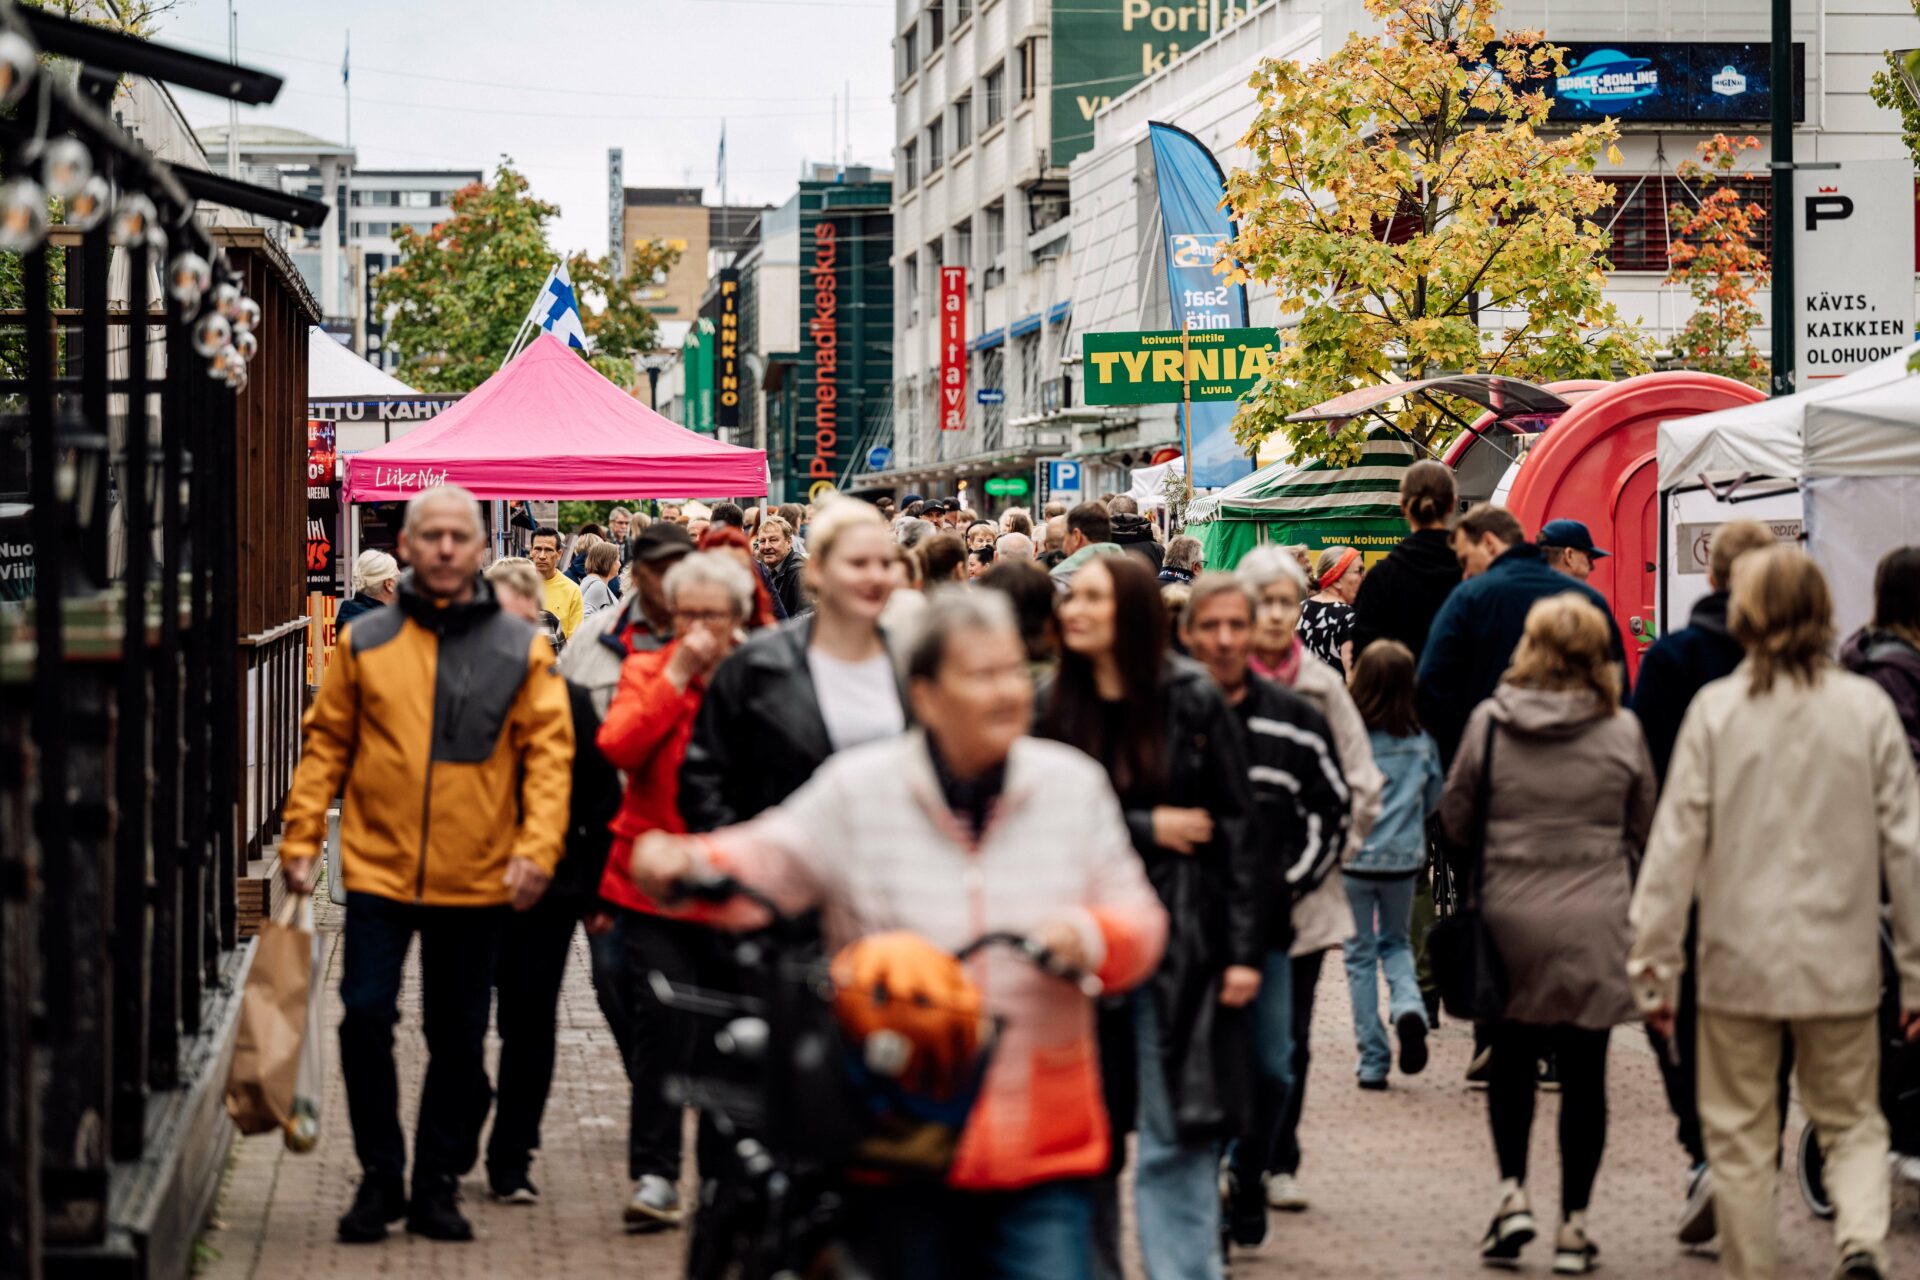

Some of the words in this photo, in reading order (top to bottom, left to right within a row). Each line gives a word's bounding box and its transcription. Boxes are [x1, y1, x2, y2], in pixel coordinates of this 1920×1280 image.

[1143, 43, 1187, 76] ki
[1806, 292, 1876, 312] KÄVIS,
[1141, 333, 1225, 345] koivuntrnitila
[1807, 320, 1904, 338] KAIKKIEN
[721, 281, 738, 407] FINNKINO
[809, 222, 837, 478] Promenadikeskus
[944, 269, 961, 428] Taitava
[1090, 343, 1273, 384] TYRNIÄ
[1200, 385, 1233, 395] LUVIA
[379, 401, 457, 420] KAHV
[1057, 464, 1076, 489] P
